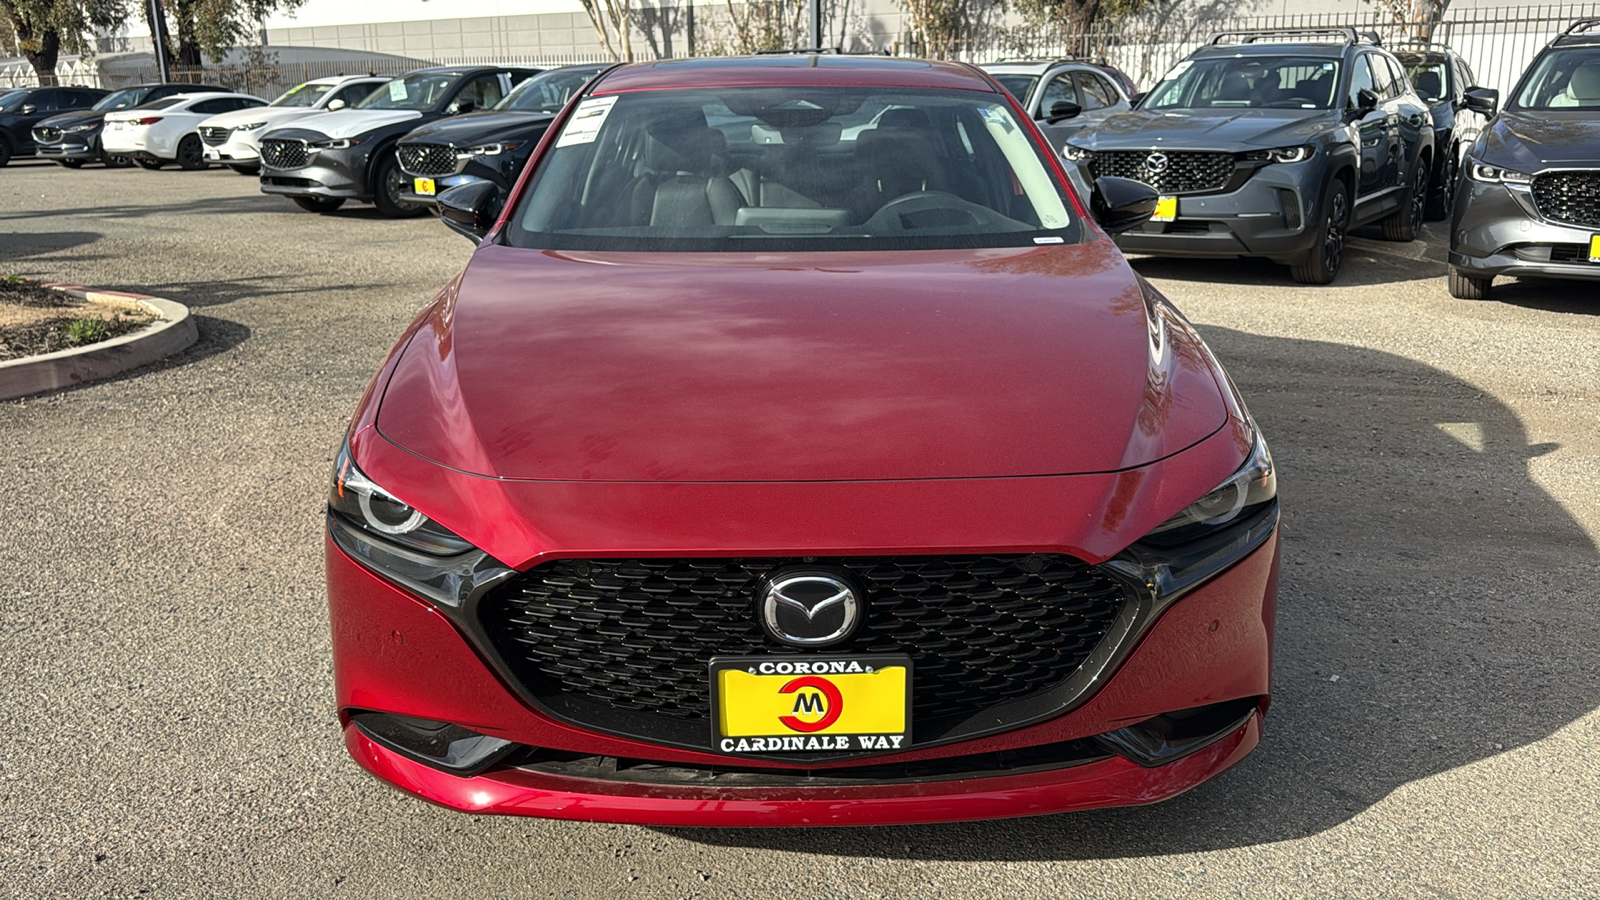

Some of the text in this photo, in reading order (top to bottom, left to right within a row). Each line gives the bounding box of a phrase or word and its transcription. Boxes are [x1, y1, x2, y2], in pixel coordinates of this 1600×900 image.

[758, 661, 863, 674] CORONA
[720, 735, 905, 752] CARDINALE WAY
